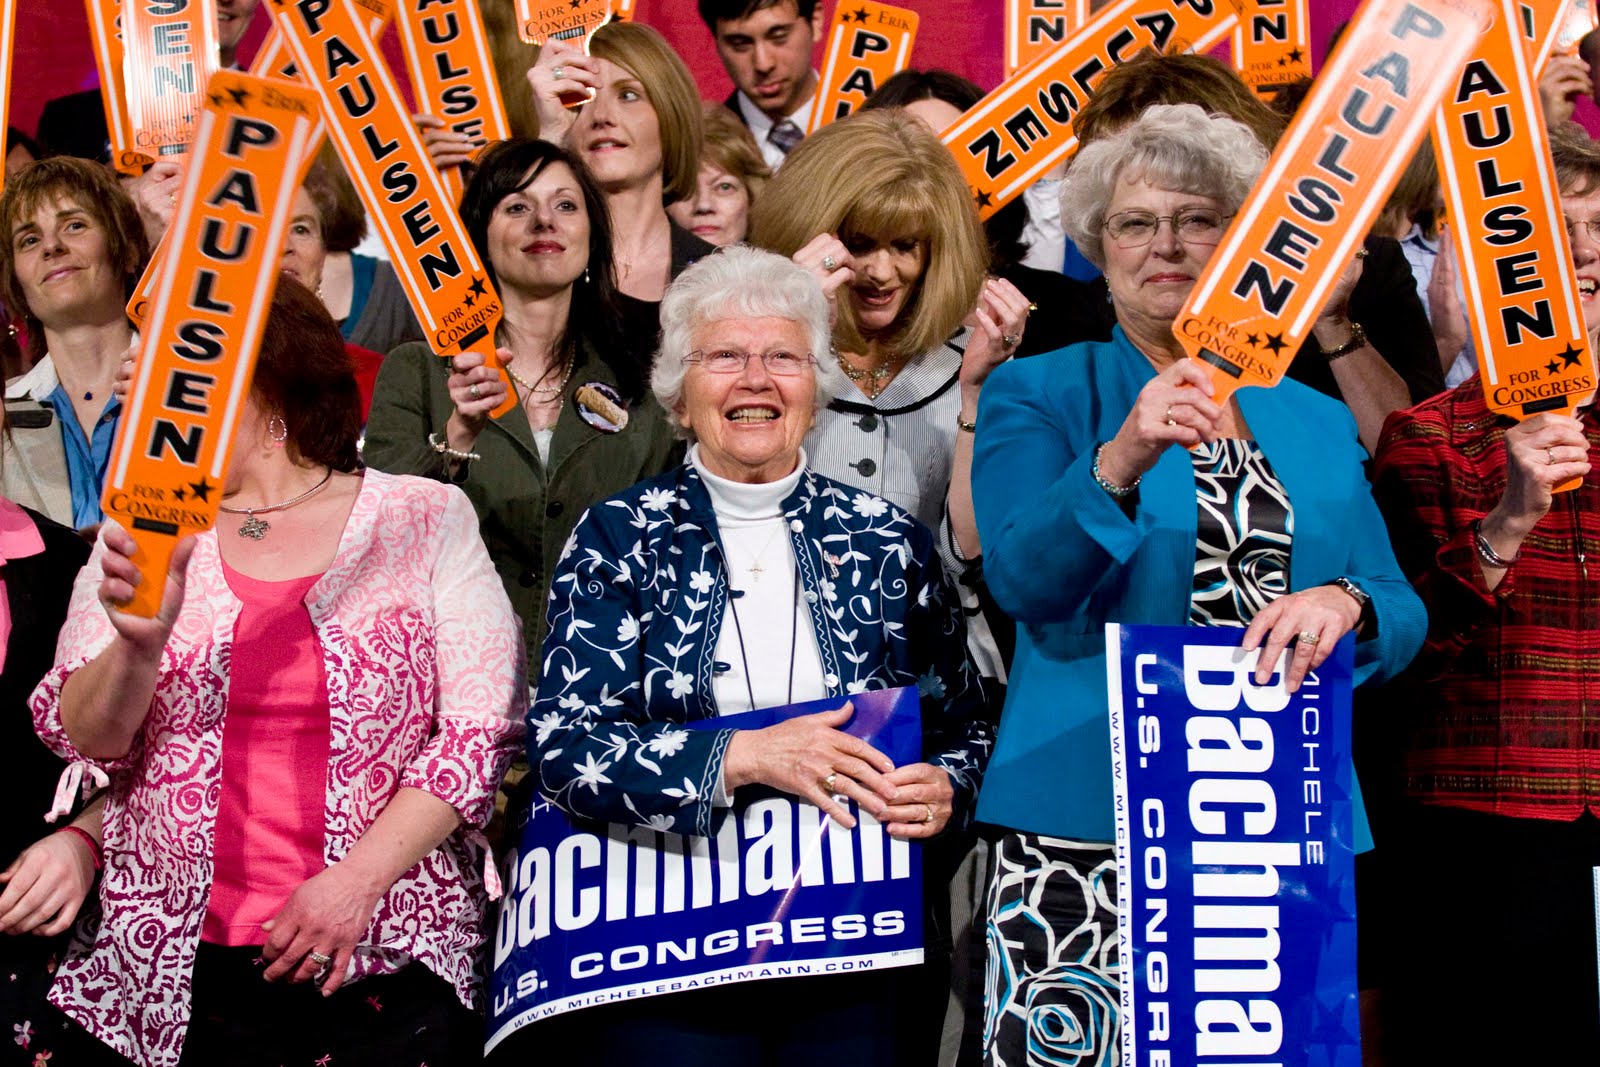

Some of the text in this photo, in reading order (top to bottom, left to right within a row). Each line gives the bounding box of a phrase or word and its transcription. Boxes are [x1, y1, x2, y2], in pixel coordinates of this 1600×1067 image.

[526, 8, 606, 37] CONGRESS
[539, 6, 565, 20] FOR
[299, 0, 463, 291] PAULSEN
[1233, 3, 1446, 317] PAULSEN
[148, 116, 279, 464] PAULSEN
[442, 307, 465, 327] FOR
[436, 300, 499, 348] CONGRESS
[1182, 318, 1274, 381] CONGRESS
[1208, 316, 1239, 340] FOR
[1493, 375, 1591, 406] CONGRESS
[1508, 369, 1541, 386] FOR
[1135, 653, 1161, 769] U.S.
[1183, 645, 1301, 1067] Bachma
[493, 909, 906, 1017] U.S. CONGRESS
[513, 959, 874, 1030] WWW.MICHELEBACHMANN.COM
